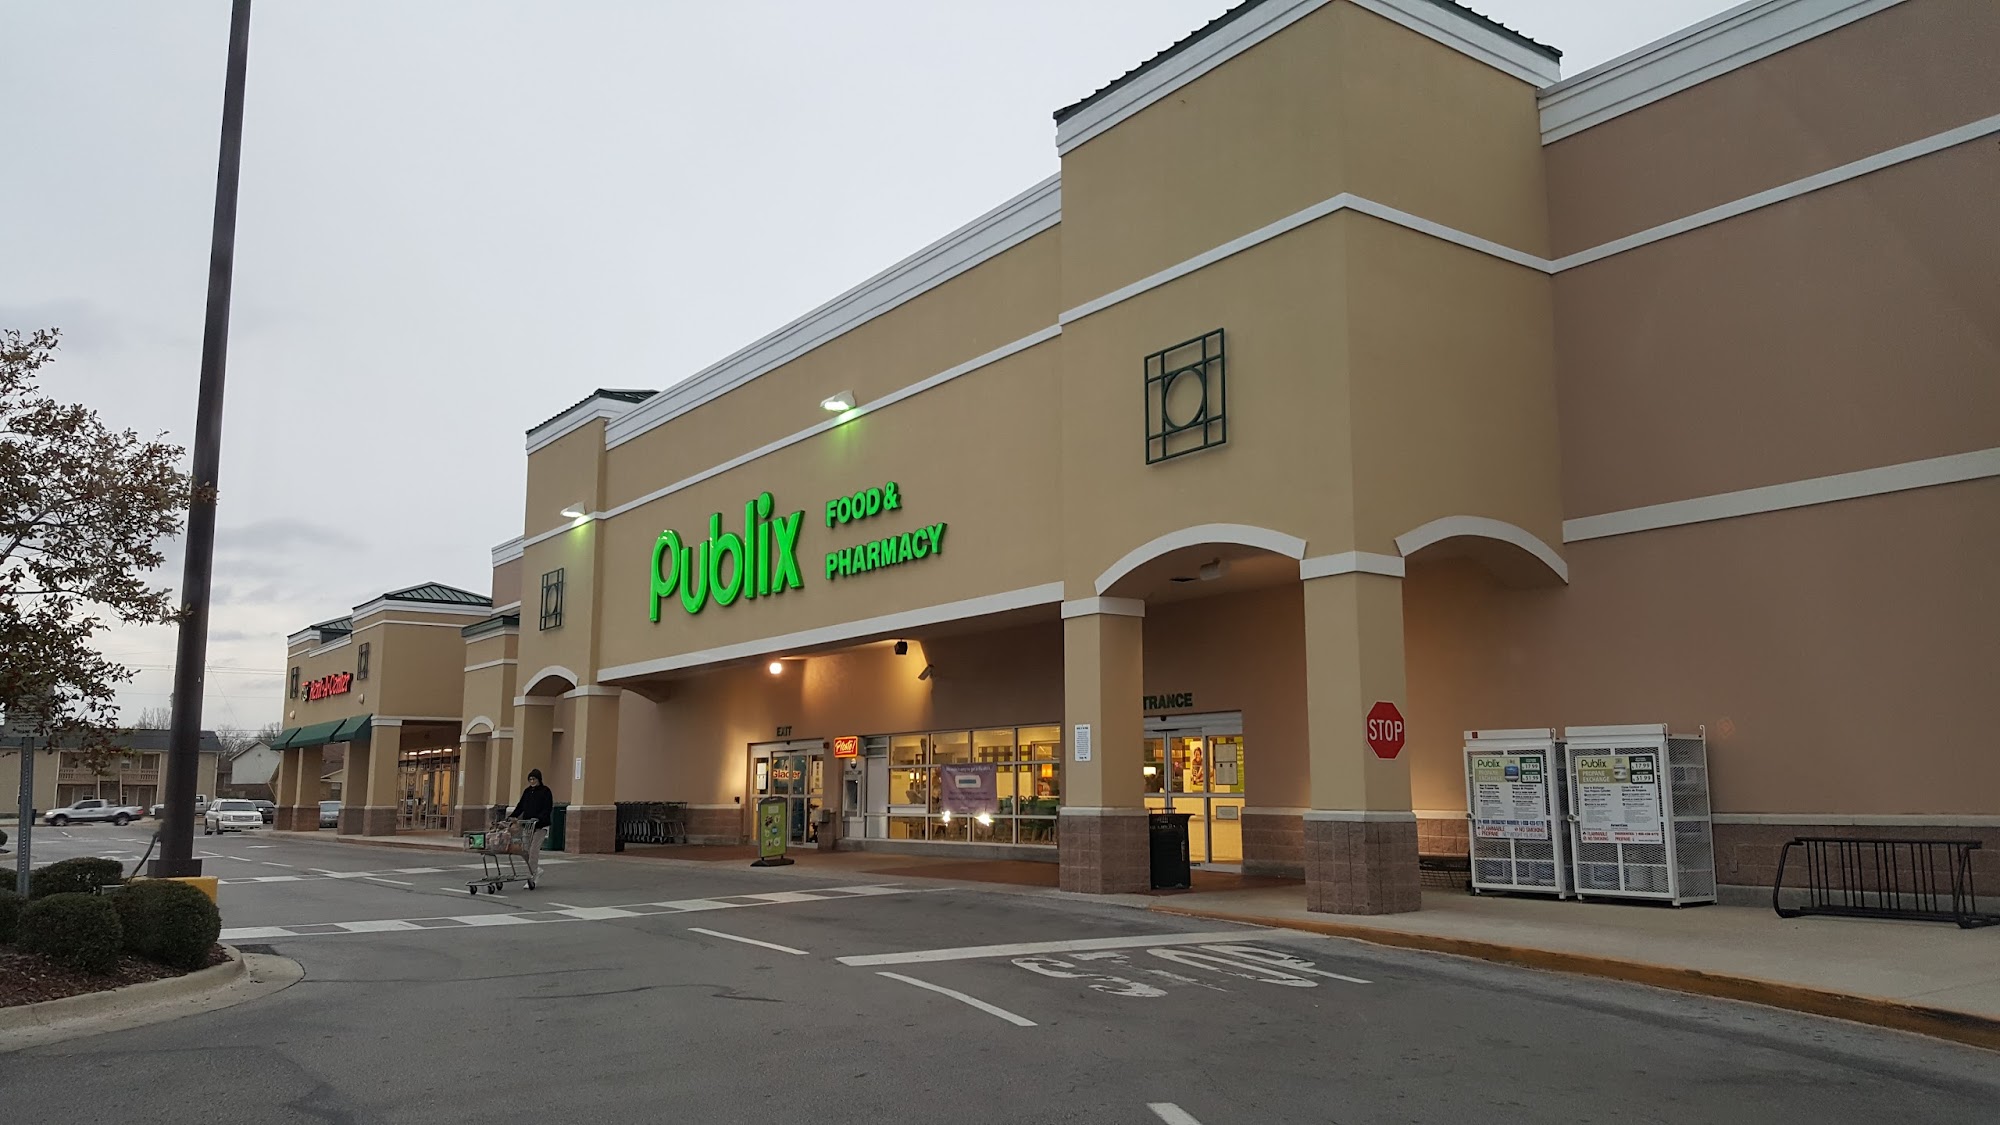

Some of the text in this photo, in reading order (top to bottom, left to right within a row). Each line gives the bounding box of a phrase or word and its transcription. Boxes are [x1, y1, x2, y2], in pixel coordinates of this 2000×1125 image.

[825, 480, 902, 528] FOOD &
[650, 491, 805, 623] Publix
[825, 522, 948, 580] PHARMACY
[1143, 692, 1193, 710] TRANCE
[776, 726, 793, 737] EXIT
[1369, 718, 1403, 742] STOP
[1581, 758, 1607, 768] Publix
[772, 769, 801, 780] Glacer
